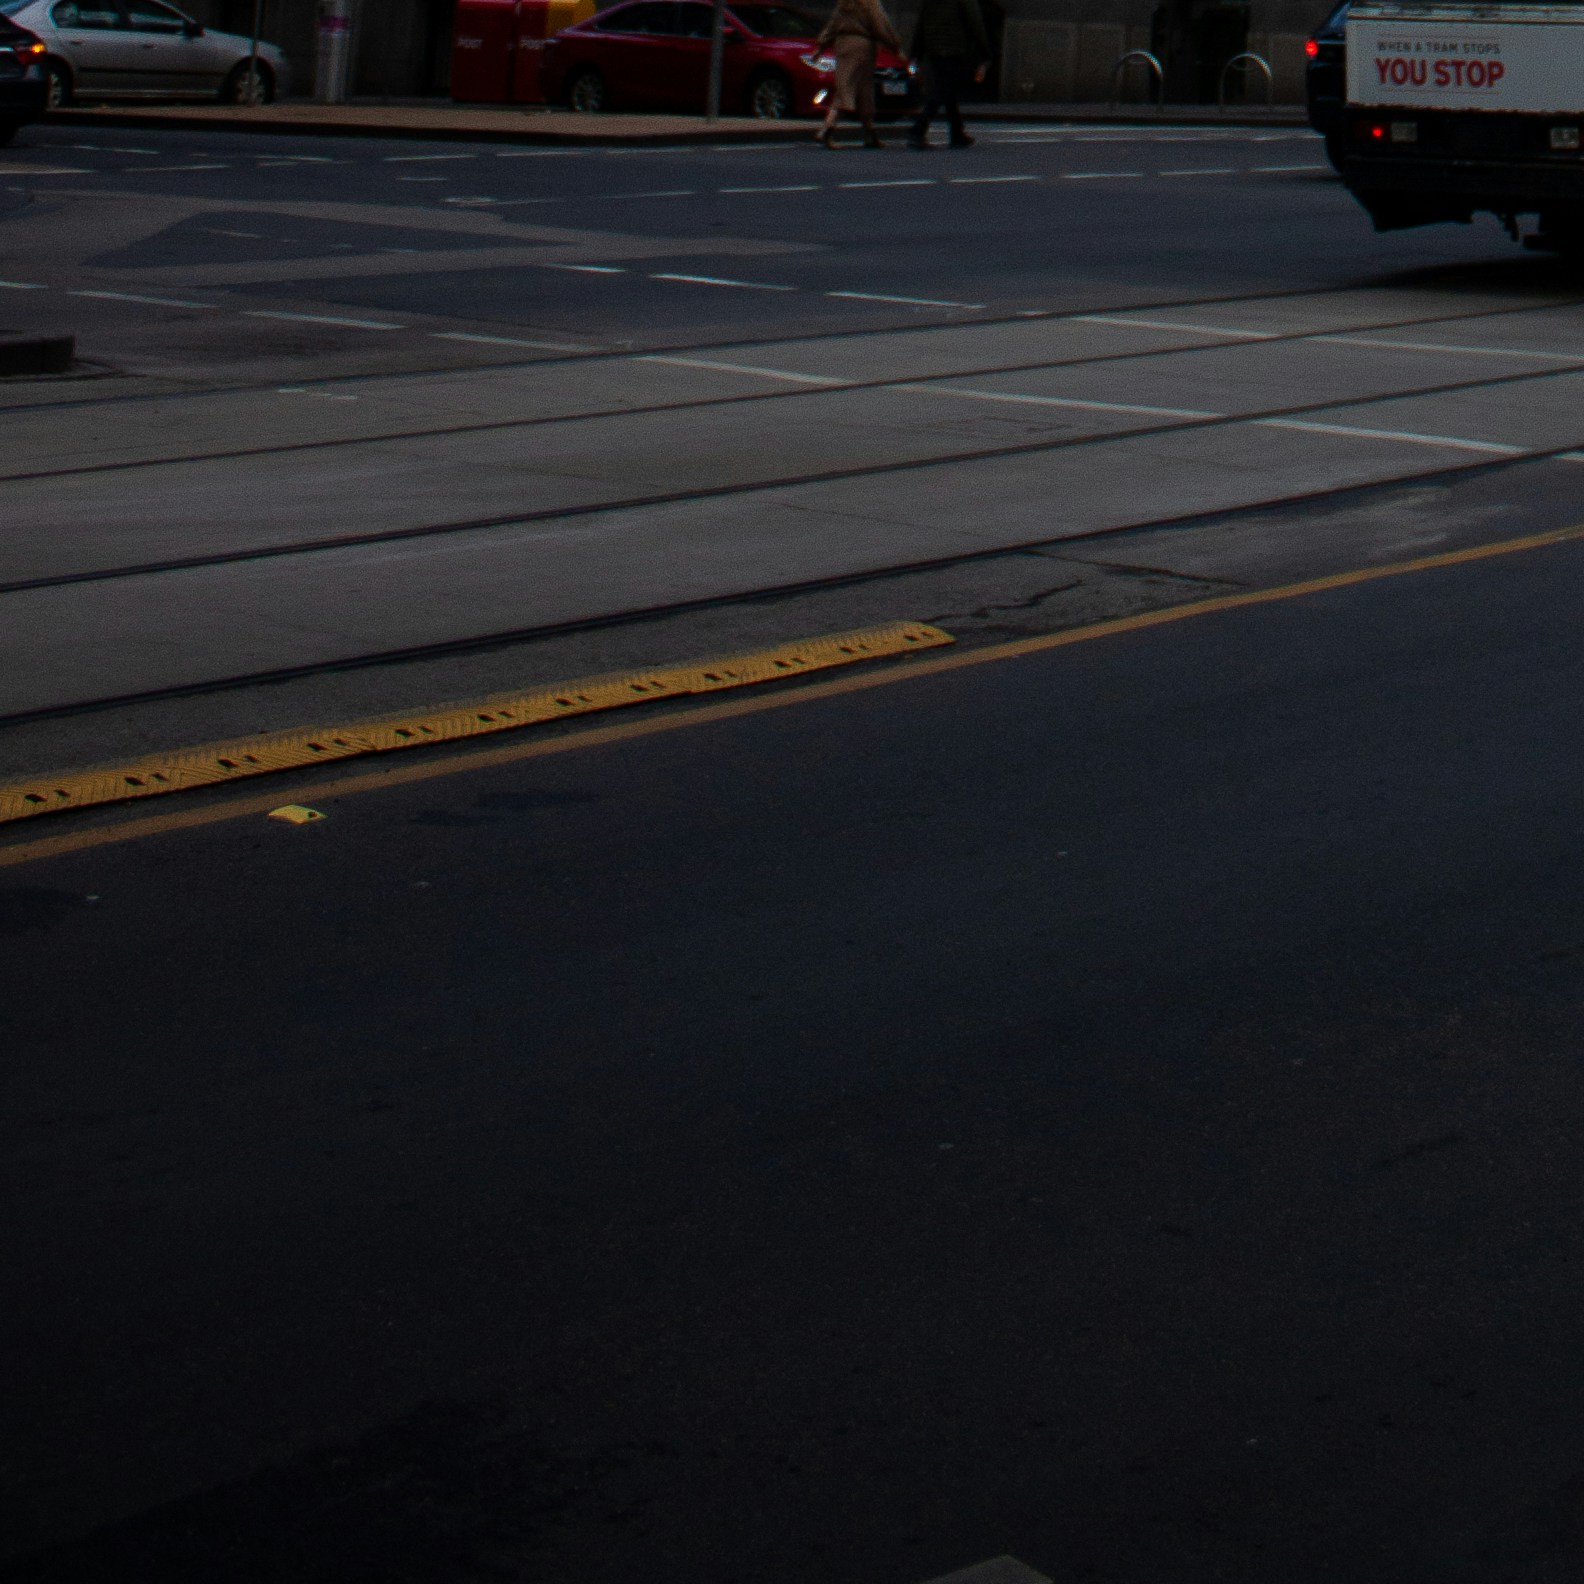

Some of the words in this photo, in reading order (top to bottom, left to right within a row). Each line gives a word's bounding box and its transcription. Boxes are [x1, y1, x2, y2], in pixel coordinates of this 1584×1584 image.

[1377, 41, 1411, 52] WHEN
[1415, 41, 1422, 52] A
[1426, 41, 1458, 52] TRAM
[1462, 42, 1500, 55] STOPS
[1375, 56, 1427, 86] YOU
[1434, 58, 1505, 88] STOP
